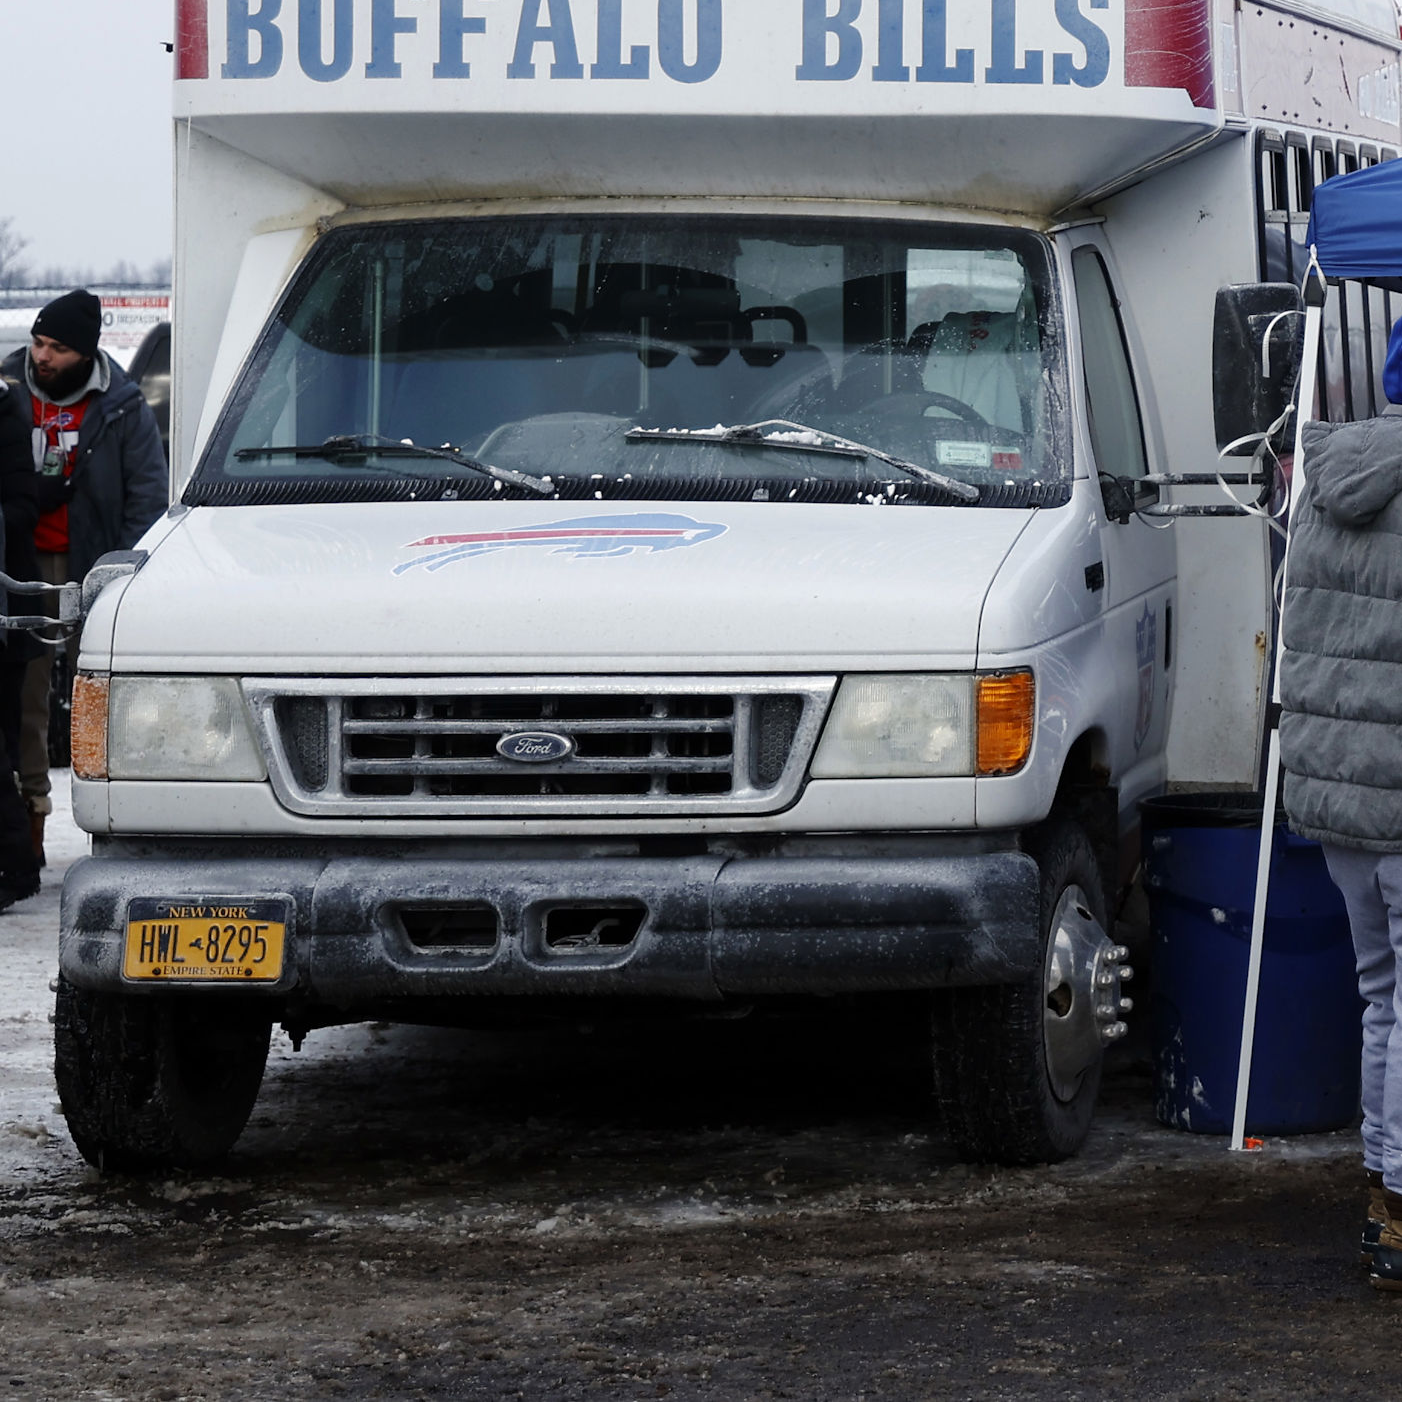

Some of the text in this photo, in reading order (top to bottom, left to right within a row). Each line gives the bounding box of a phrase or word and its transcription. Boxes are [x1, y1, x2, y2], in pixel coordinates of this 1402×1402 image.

[514, 737, 552, 754] Ford
[169, 906, 249, 919] NEW YORK
[139, 924, 269, 964] HWL 8295
[163, 965, 244, 976] EMPIRE STATE
